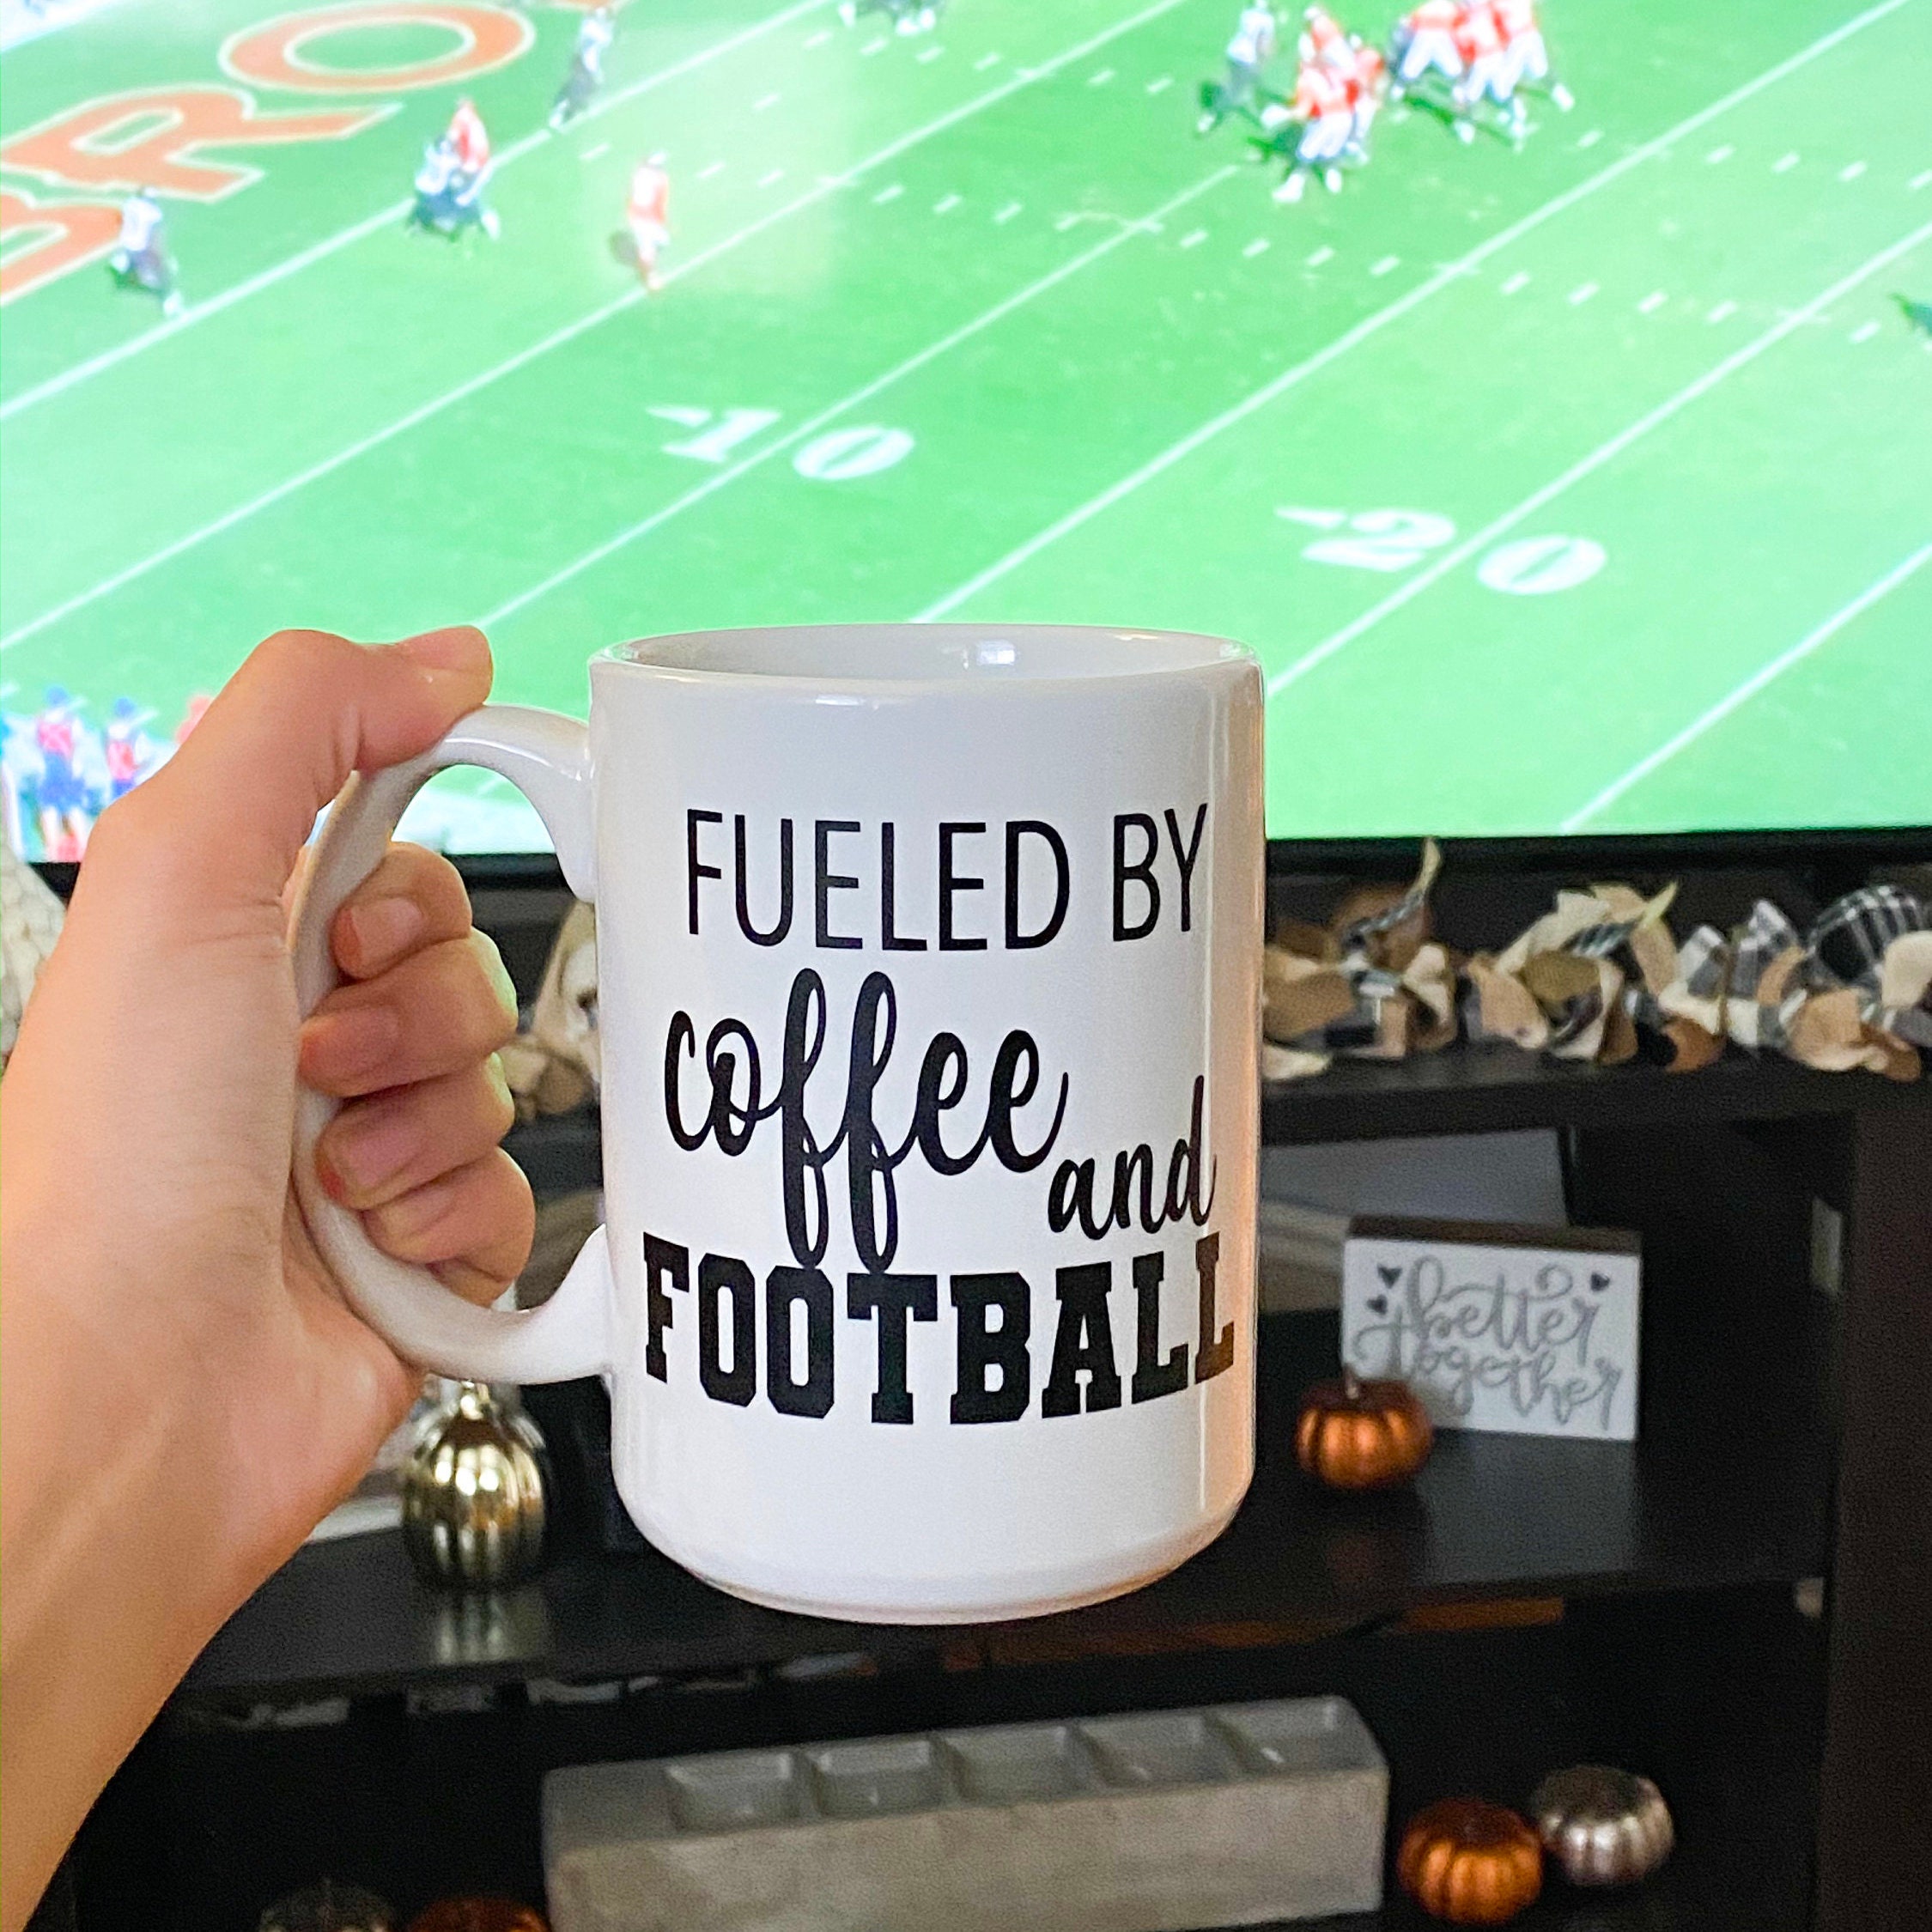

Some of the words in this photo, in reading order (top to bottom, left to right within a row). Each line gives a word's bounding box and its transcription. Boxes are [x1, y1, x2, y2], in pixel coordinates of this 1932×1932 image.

[0, 0, 635, 307] BRO
[687, 808, 1071, 951] FUELED
[1111, 803, 1209, 943] BY
[664, 968, 1070, 1273] coffee
[1048, 1075, 1218, 1241] and
[643, 1230, 1235, 1425] FOOTBALL
[1352, 1304, 1621, 1431] together
[1406, 1255, 1600, 1364] better
